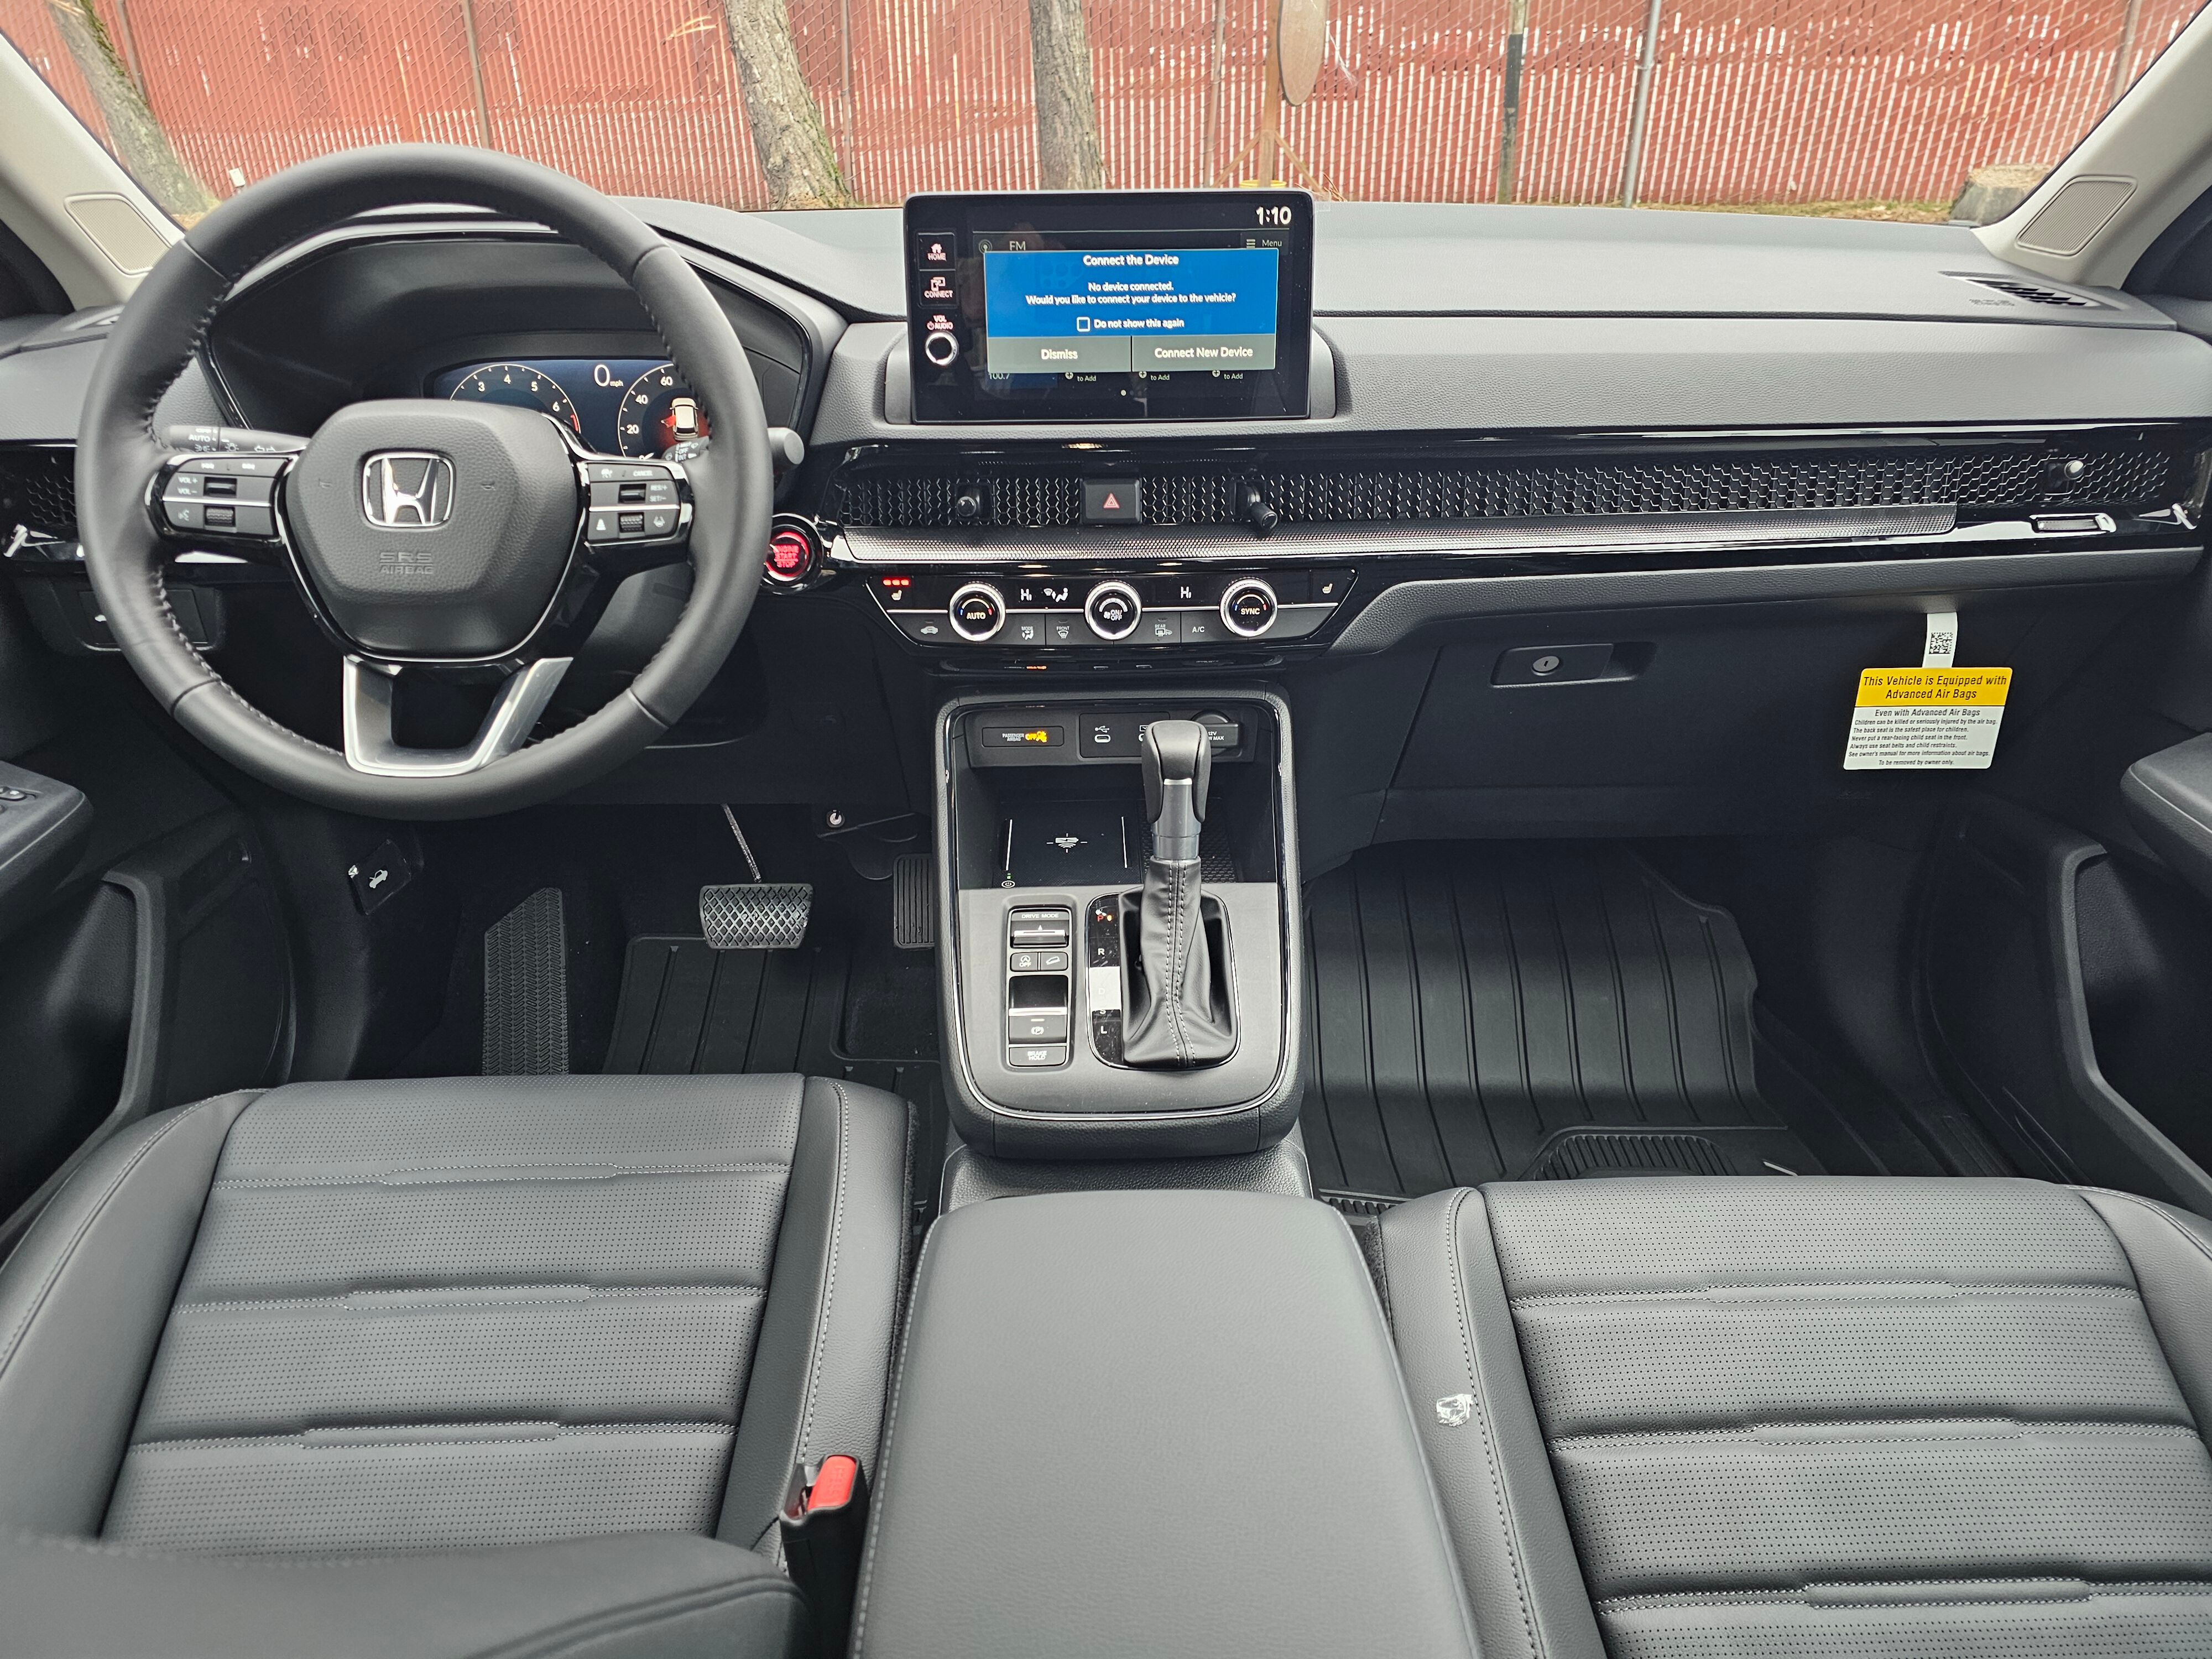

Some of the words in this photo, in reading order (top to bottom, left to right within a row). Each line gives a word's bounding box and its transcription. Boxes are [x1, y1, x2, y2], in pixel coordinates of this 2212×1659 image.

[1256, 206, 1292, 225] 1:10
[1009, 241, 1026, 251] FM
[927, 253, 946, 261] HOME
[1083, 255, 1125, 266] Connect
[1126, 254, 1143, 265] the
[1145, 254, 1179, 265] Device
[1088, 282, 1101, 292] No
[1102, 282, 1128, 291] device
[1129, 281, 1174, 291] connected.
[1025, 295, 1054, 305] Would
[1055, 297, 1071, 305] you
[1072, 295, 1086, 304] like
[1087, 295, 1096, 304] to
[1097, 295, 1130, 304] connect
[1131, 296, 1150, 305] your
[1151, 294, 1177, 304] device
[1178, 294, 1188, 303] to
[1189, 293, 1203, 303] the
[1205, 293, 1237, 302] vehicle?
[1093, 319, 1107, 328] Do
[1108, 319, 1122, 328] not
[1123, 319, 1145, 328] show
[1146, 319, 1161, 327] this
[1162, 318, 1185, 329] again
[1041, 349, 1079, 359] Dismiss
[1154, 347, 1194, 358] Connect
[1196, 347, 1219, 357] New
[1220, 346, 1254, 357] Device
[504, 374, 511, 384] 4
[594, 364, 610, 387] 0
[660, 376, 673, 386] 60
[478, 381, 486, 392] 3
[531, 381, 538, 392] 5
[635, 394, 648, 404] 40
[553, 401, 560, 411] 6
[626, 424, 639, 434] 20
[189, 434, 211, 442] AUTO
[379, 552, 432, 563] SRS
[379, 565, 434, 575] AIRBAG
[1864, 676, 1883, 686] This
[1887, 676, 1922, 686] Vehicle
[1925, 676, 1934, 685] is
[1937, 676, 1983, 687] Equipped
[1986, 675, 2007, 685] with
[1885, 689, 1933, 699] Advanced
[1935, 689, 1950, 698] Air
[1953, 688, 1977, 700] Bags
[1961, 708, 1980, 717] Bags
[1100, 1025, 1108, 1034] L
